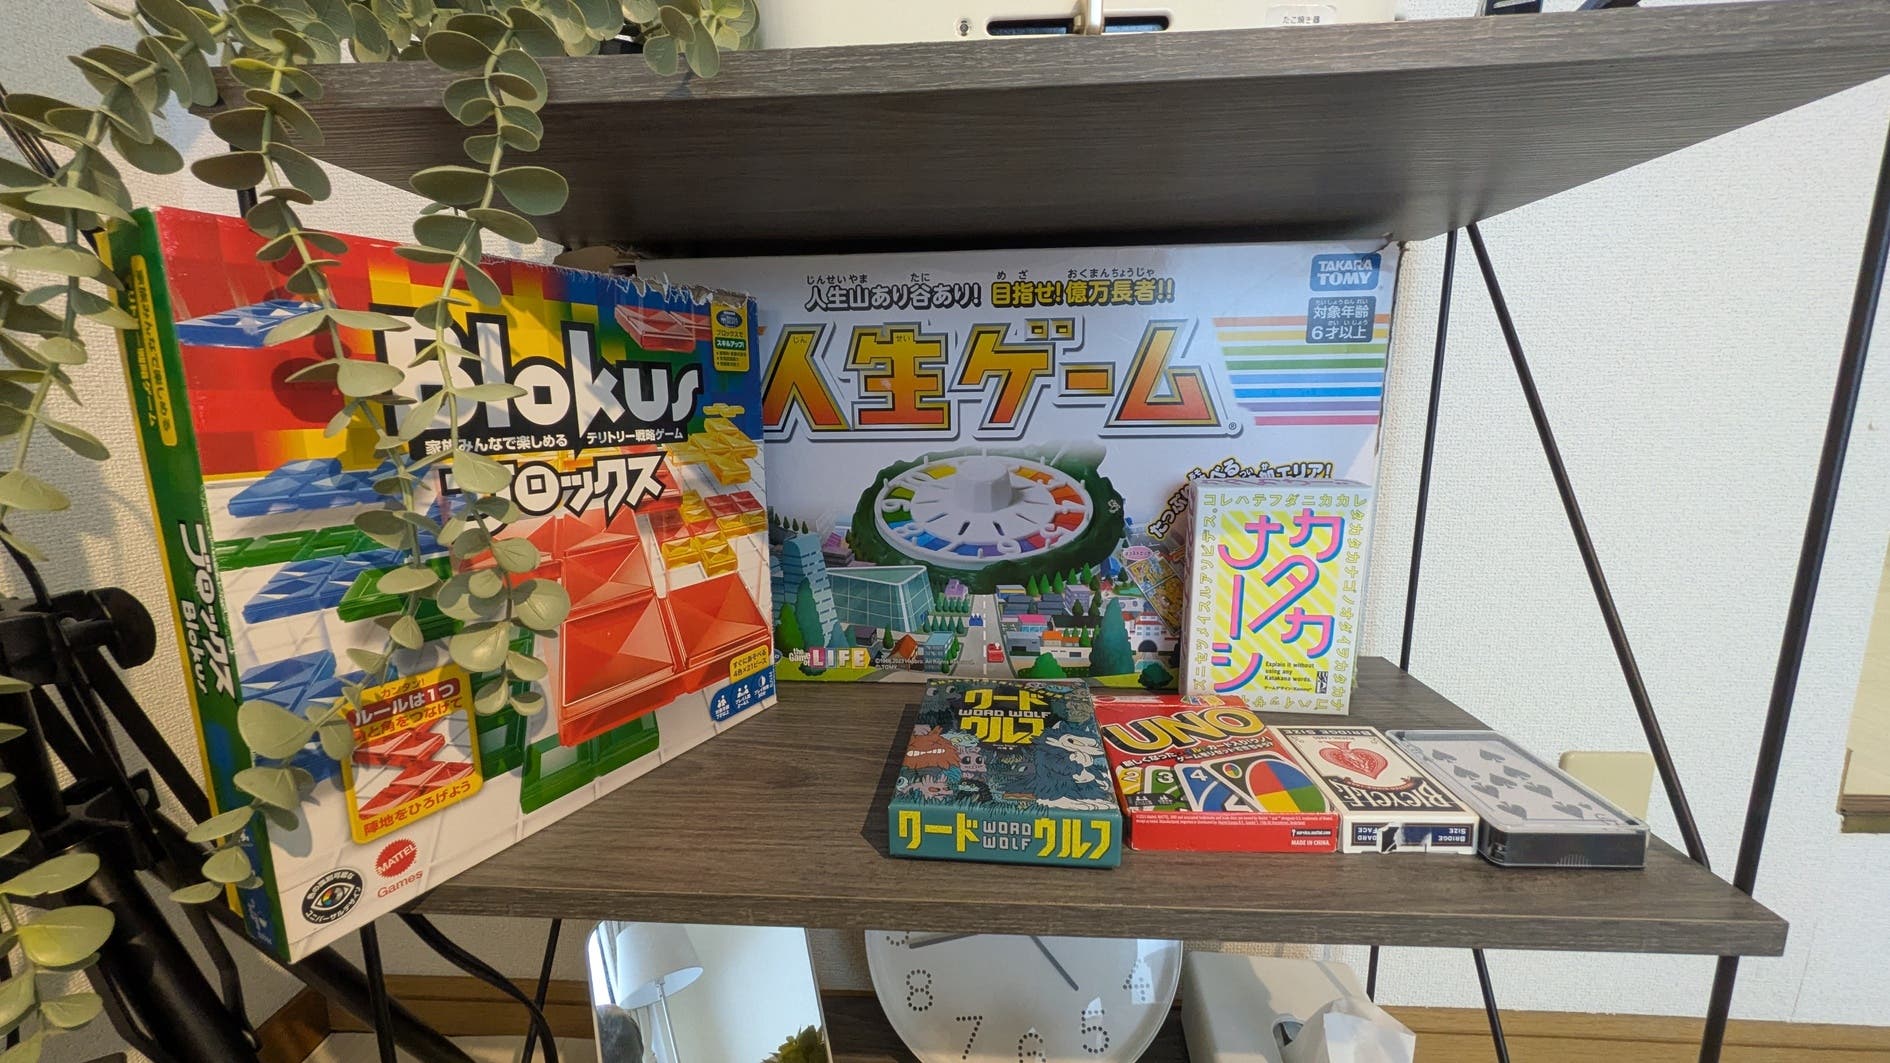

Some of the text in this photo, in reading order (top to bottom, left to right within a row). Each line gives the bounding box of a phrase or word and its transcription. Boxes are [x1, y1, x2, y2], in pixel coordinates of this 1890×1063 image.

[910, 272, 931, 282] たに
[996, 271, 1006, 280] め
[1317, 271, 1372, 285] TOMY
[1318, 259, 1373, 271] TAKARA
[1313, 304, 1369, 319] 対象年齢
[1311, 326, 1367, 339] 6才以上
[384, 315, 699, 438] Blokus
[760, 318, 1222, 431] 人生ゲーム
[586, 427, 683, 445] テリトリー戦略ゲーム
[443, 454, 662, 533] ロックス
[179, 523, 236, 699] ブロックス
[181, 600, 207, 694] Blokus
[812, 649, 866, 668] LIFE
[381, 678, 425, 698] カンタン!
[964, 689, 1049, 711] ワード
[355, 684, 455, 726] ルールは1つ
[958, 709, 1051, 718] WORD WOLF
[960, 716, 1045, 744] ウルフ
[1102, 706, 1267, 754] UNO
[1122, 771, 1139, 782] 2
[1157, 771, 1174, 784] 3
[1190, 769, 1208, 782] 4
[1328, 780, 1453, 808] BICYCLE
[364, 781, 472, 837] 陣地をひろげよう
[898, 810, 981, 852] ワード
[982, 820, 1033, 836] WORD
[1034, 817, 1111, 860] ウルフ
[982, 835, 1033, 850] WOLF
[377, 844, 416, 874] MATTEL
[377, 870, 424, 898] Games
[906, 969, 933, 1011] 8
[956, 1015, 982, 1060] 7
[1081, 1009, 1109, 1053] 5
